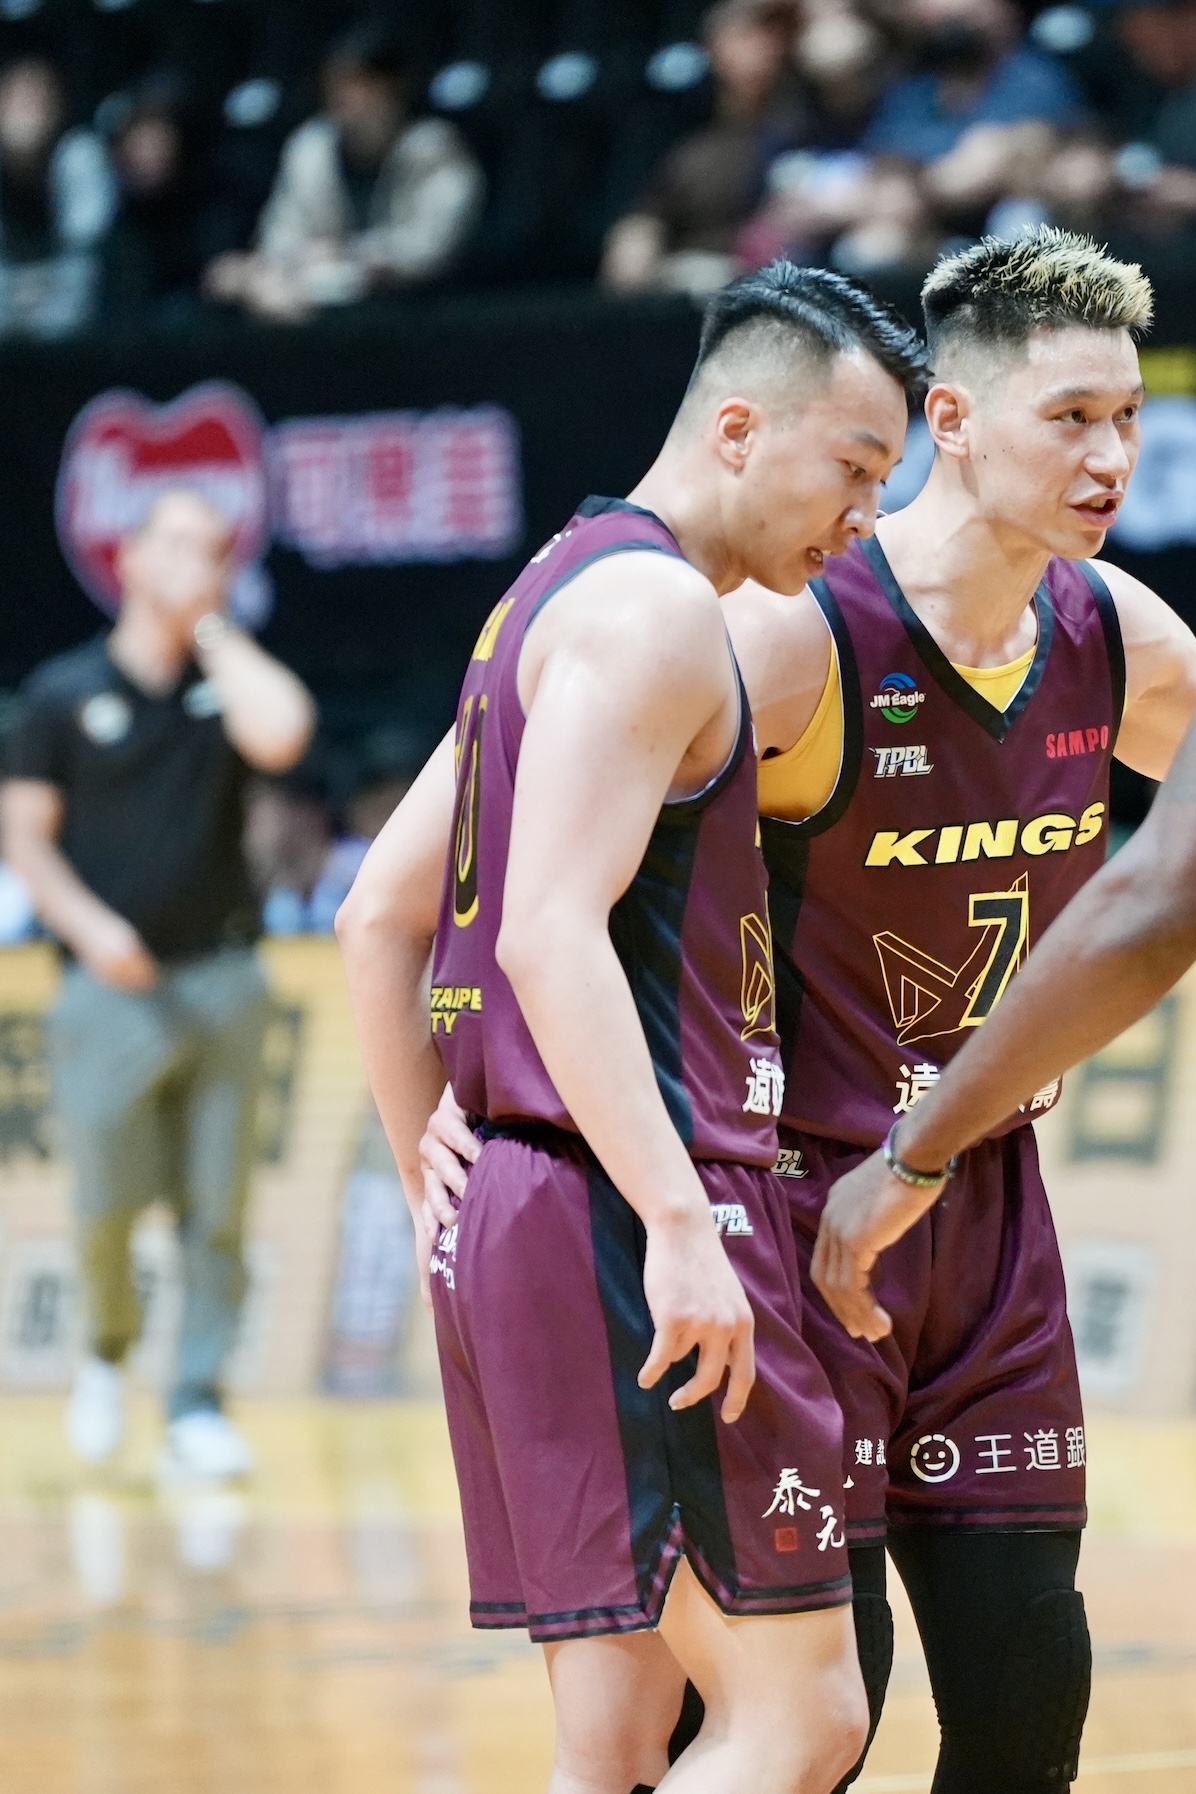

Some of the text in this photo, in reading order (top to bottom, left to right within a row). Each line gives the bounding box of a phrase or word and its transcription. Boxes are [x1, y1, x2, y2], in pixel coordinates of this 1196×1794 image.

[869, 690, 926, 709] JM Eagle
[1045, 724, 1109, 759] SAMPO
[869, 745, 934, 778] TPBL
[864, 801, 1105, 867] KINGS
[959, 890, 1029, 1027] 7
[430, 987, 483, 1011] TAIPE
[430, 1011, 458, 1035] TY
[771, 1148, 810, 1179] BL
